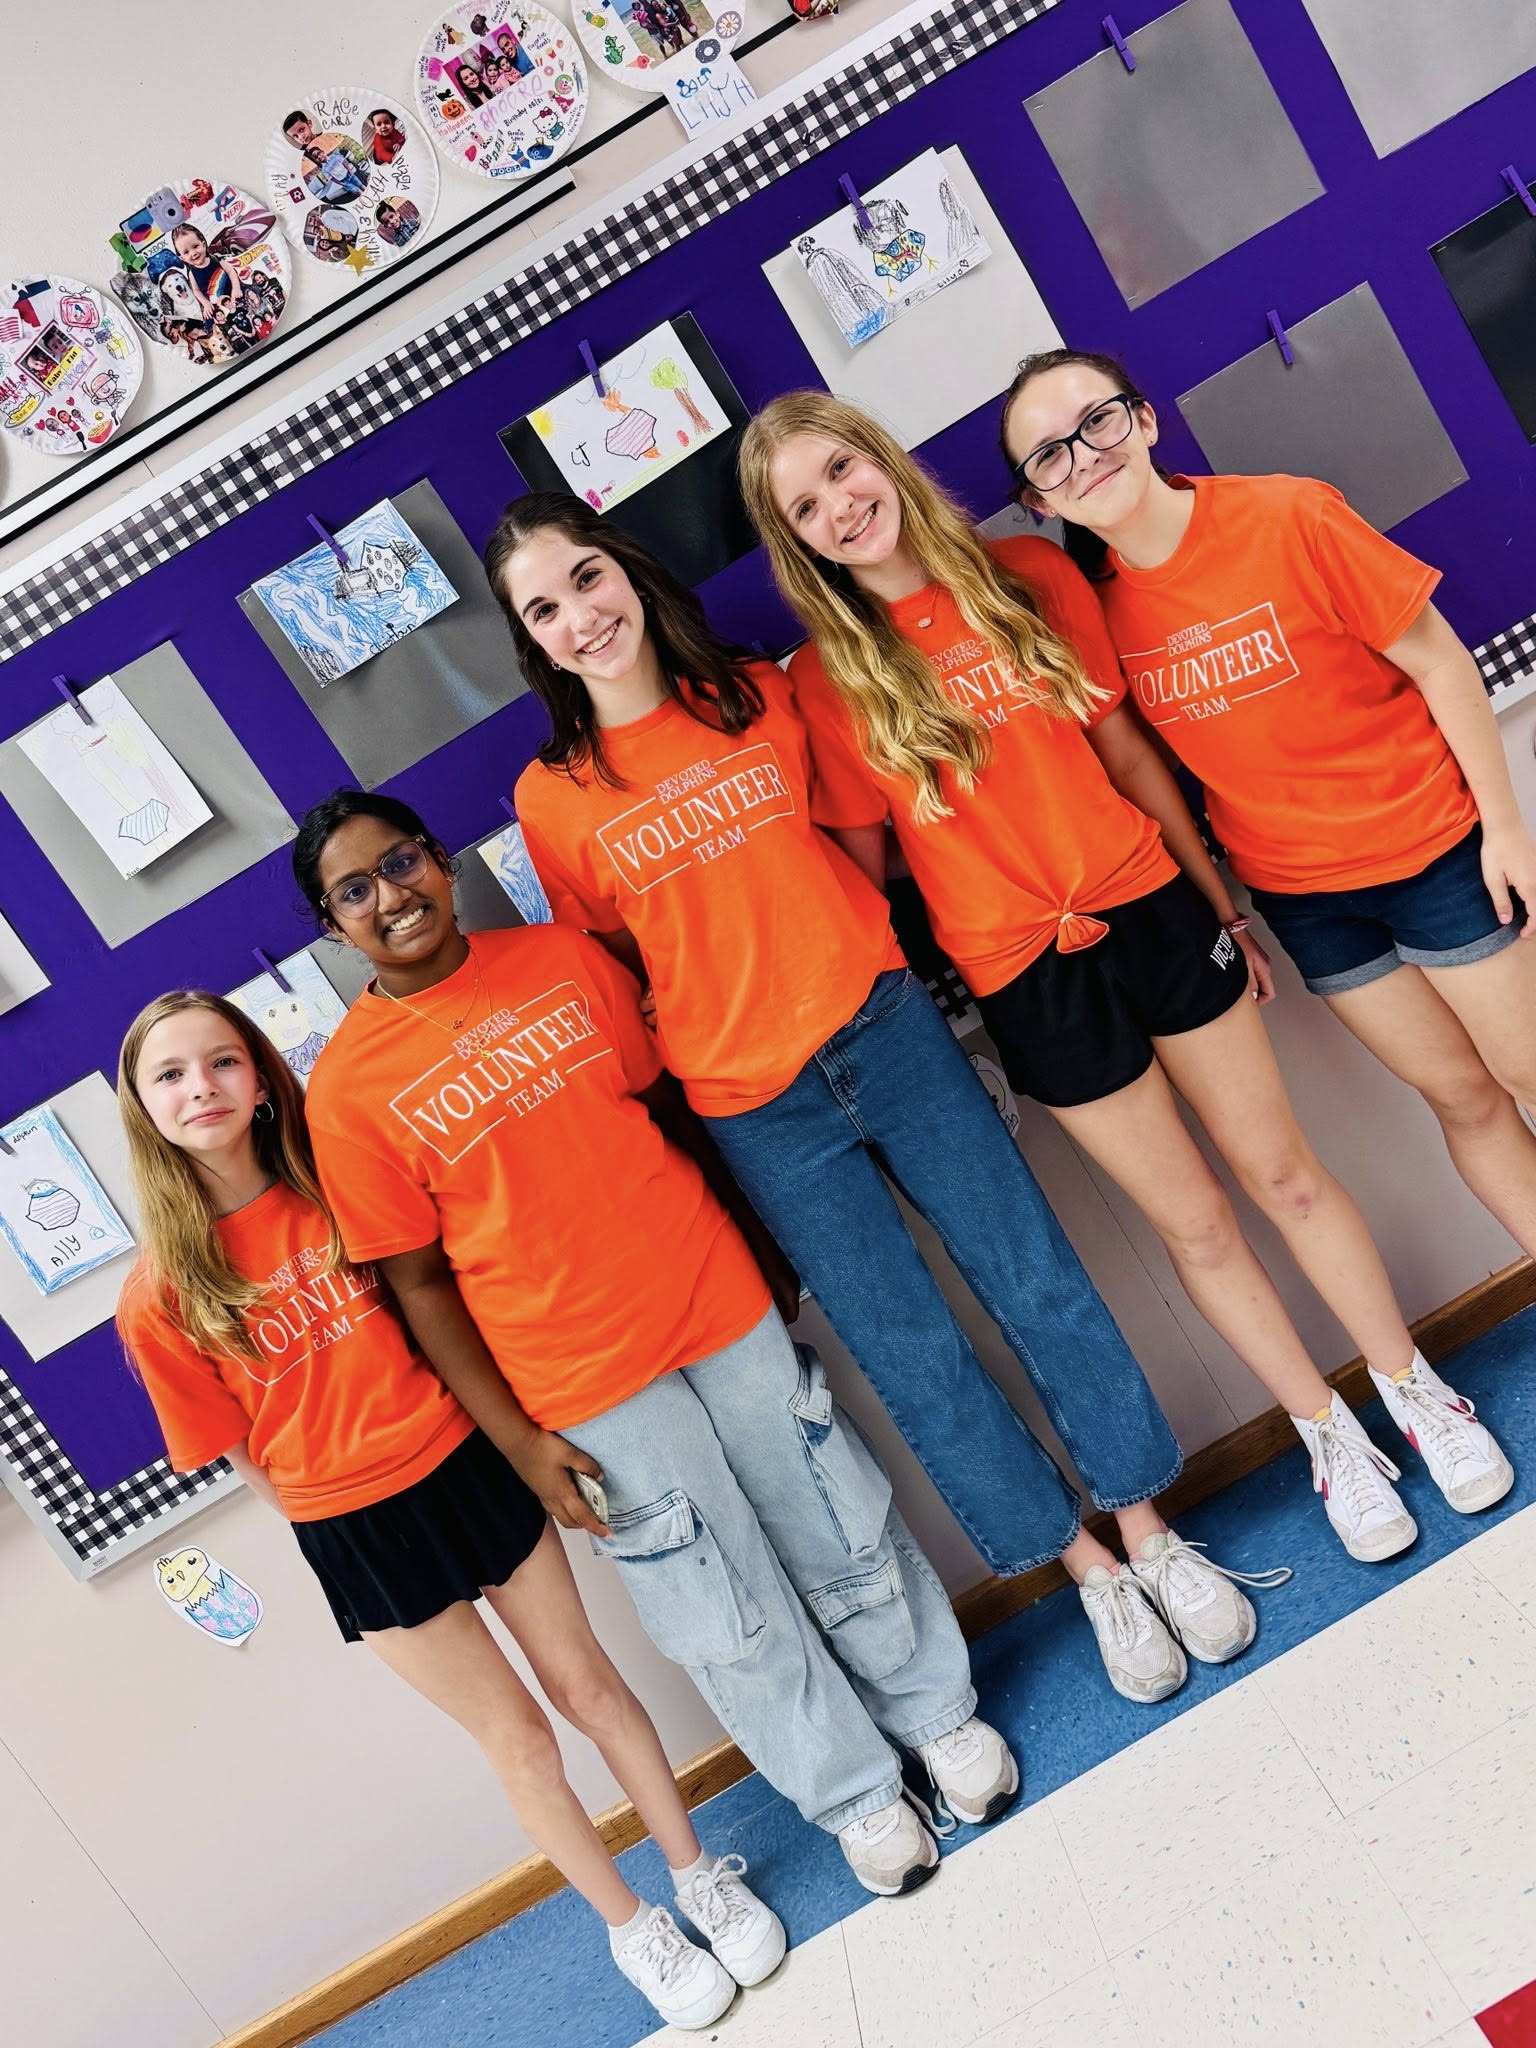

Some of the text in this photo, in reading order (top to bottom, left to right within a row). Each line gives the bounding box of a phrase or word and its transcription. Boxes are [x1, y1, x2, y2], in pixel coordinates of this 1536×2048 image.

[929, 639, 977, 667] EVOTED
[1166, 621, 1209, 647] DEVOTED
[1168, 630, 1213, 658] DOLPHINS
[934, 647, 983, 677] OLPHINS
[1180, 695, 1232, 721] TEAM
[655, 759, 711, 795] DEVOTED
[659, 767, 718, 805] DOLPHINS
[614, 763, 788, 872] VOLUNTEER
[693, 824, 748, 865] TEAM
[451, 1008, 512, 1051] DEVOTED
[457, 1014, 521, 1061] DOLPHINS
[413, 1000, 598, 1136] VOLUNTEER
[506, 1068, 566, 1118] TEAM
[51, 1235, 82, 1268] Ally
[267, 1246, 315, 1285] DEVTED
[274, 1257, 322, 1295] DOLHINS
[312, 1314, 354, 1352] EAM
